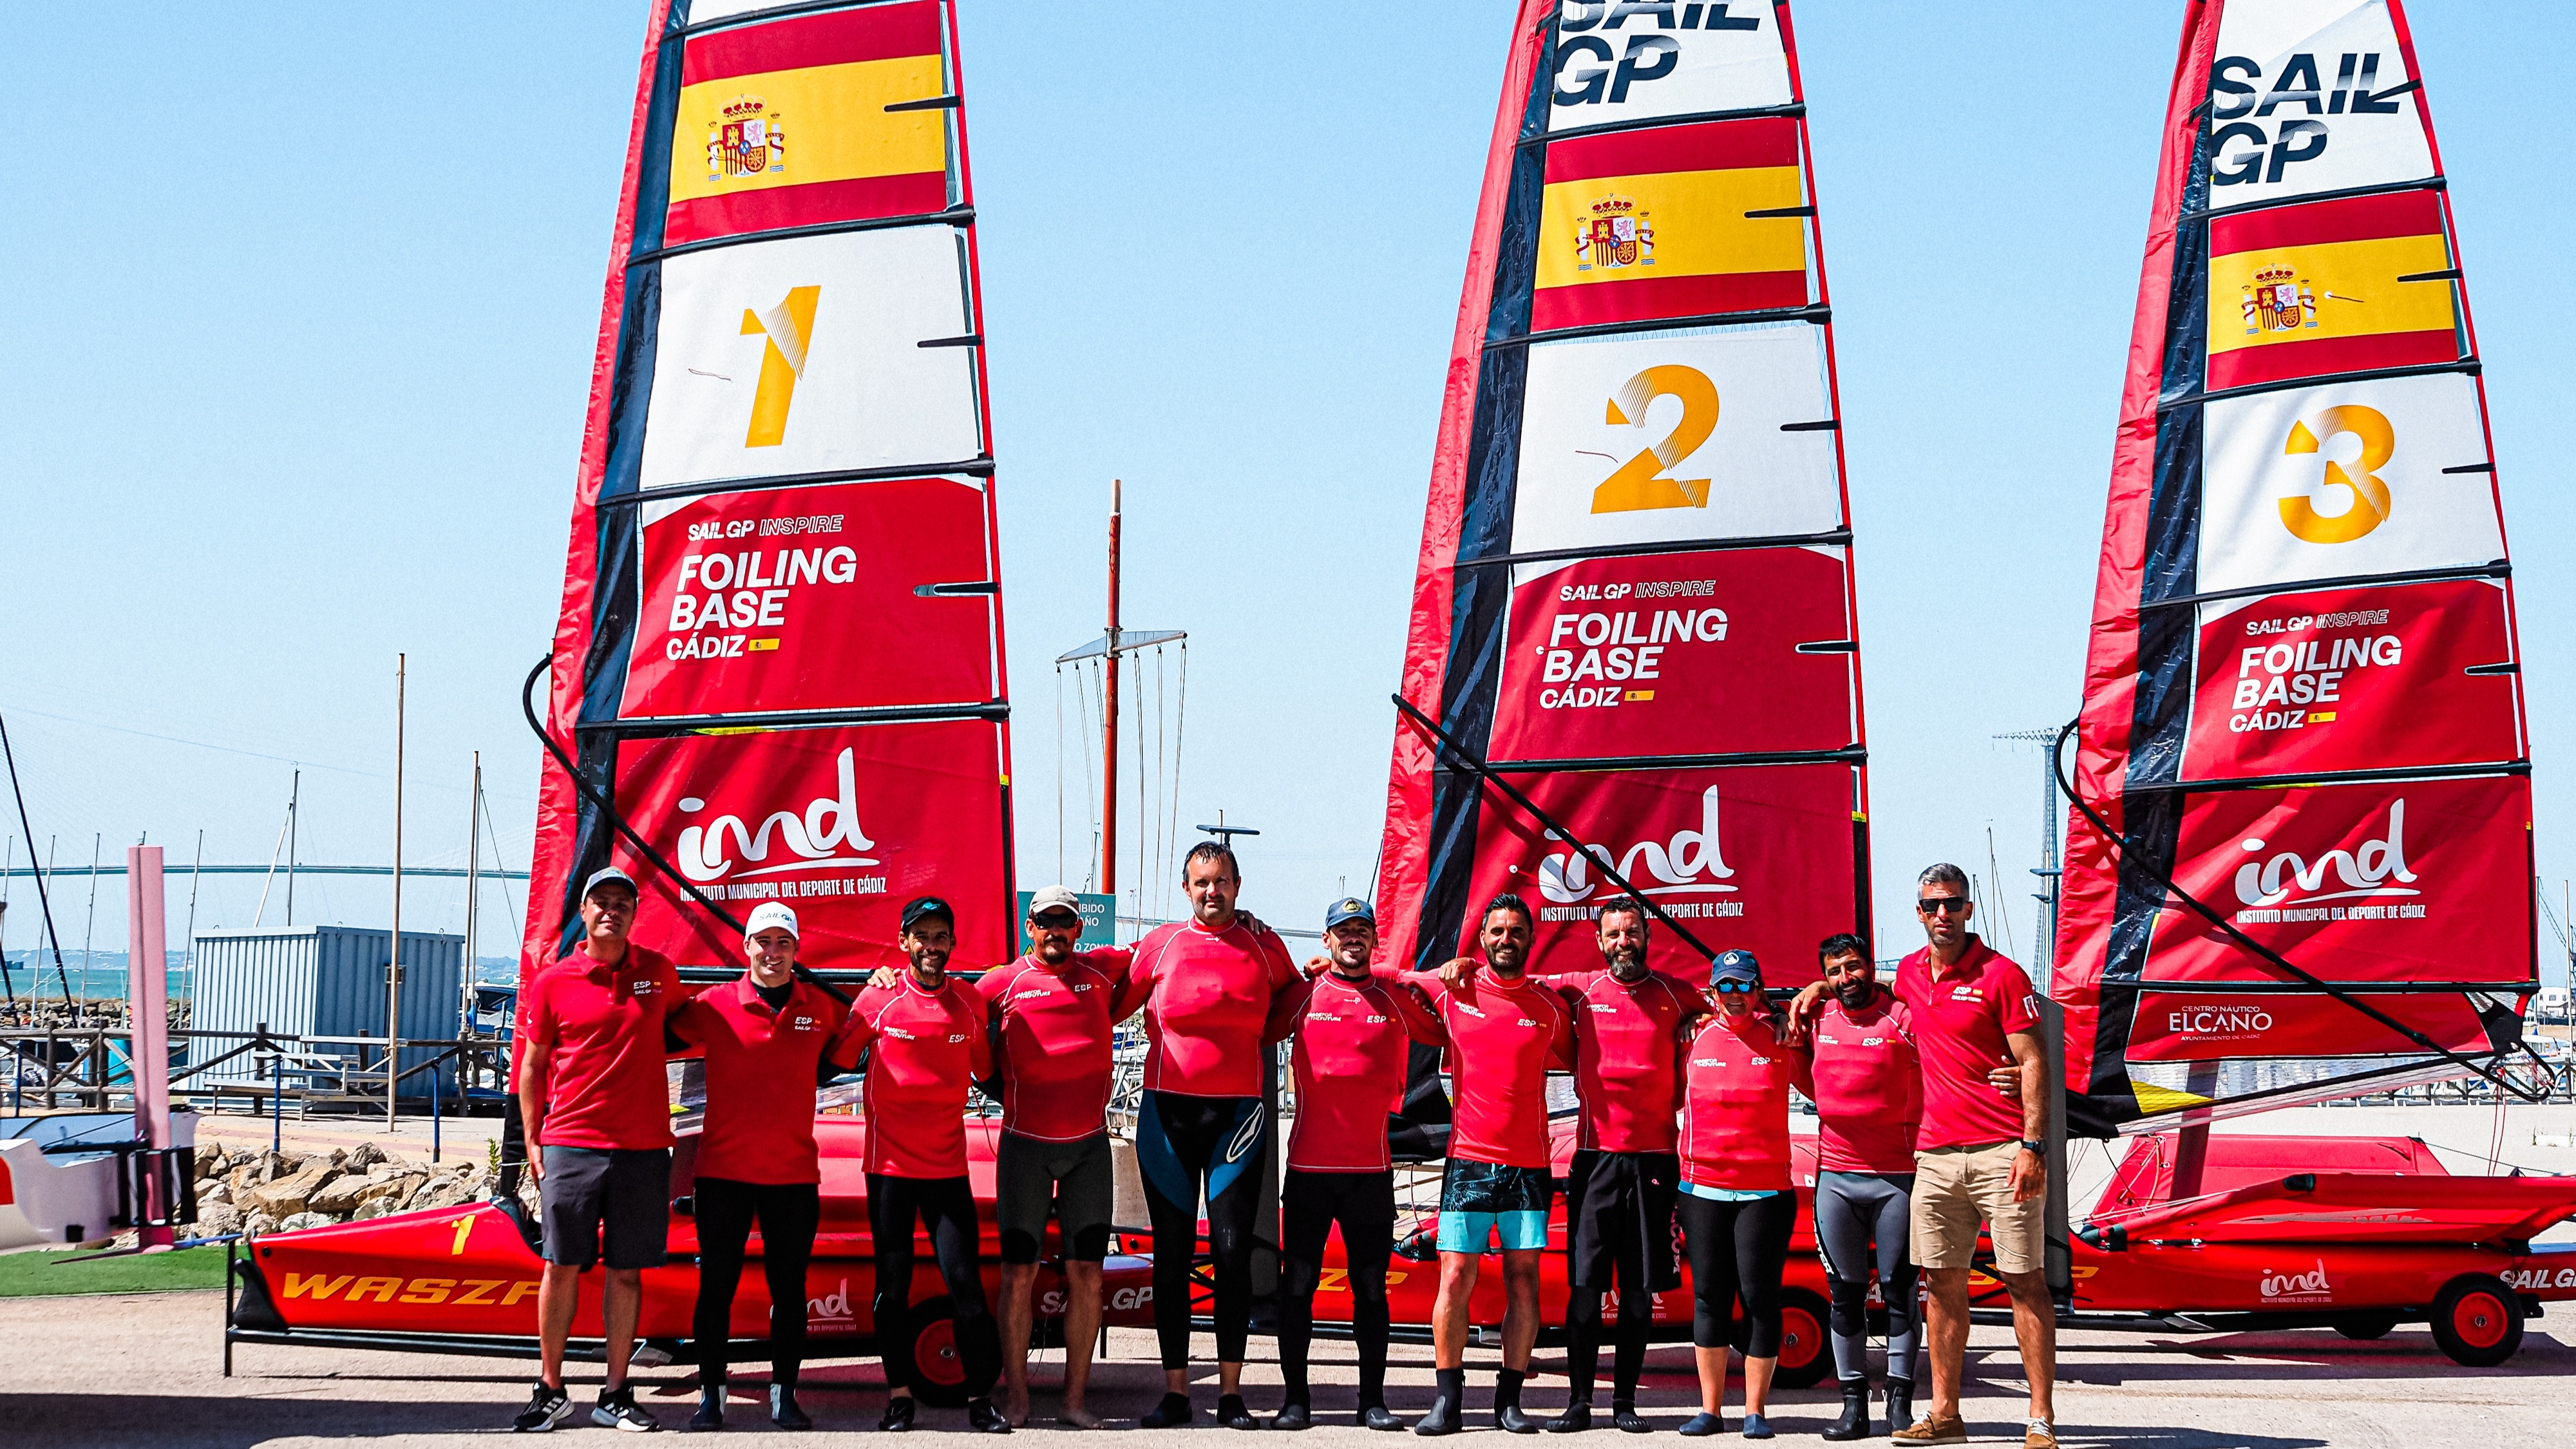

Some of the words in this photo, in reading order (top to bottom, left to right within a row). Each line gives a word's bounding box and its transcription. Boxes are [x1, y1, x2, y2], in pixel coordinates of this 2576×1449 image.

[1553, 35, 1681, 106] GP
[2213, 53, 2400, 119] SAIL
[2211, 120, 2330, 186] GP
[740, 285, 821, 448] 1
[1591, 365, 1719, 514] 2
[2278, 405, 2394, 544] 3
[759, 515, 844, 536] INSPIRE
[677, 545, 857, 592] FOILING
[1635, 580, 1716, 598] INSPIRE
[668, 589, 790, 632] BASE
[2316, 609, 2389, 629] INSPIRE
[1549, 608, 1728, 647] FOILING
[666, 632, 746, 661] CÁDIZ
[2239, 635, 2402, 679] FOILING
[1542, 646, 1665, 683] BASE
[1539, 683, 1622, 709] CÁDIZ
[2232, 672, 2343, 709] BASE
[2229, 708, 2306, 733] CÁDIZ
[677, 746, 875, 881] imd
[2235, 798, 2418, 907] imd
[728, 882, 780, 900] MUNICIPAL
[782, 881, 799, 897] DEL
[800, 879, 841, 896] DEPORTE
[843, 879, 855, 895] DE
[857, 875, 887, 893] CÁDIZ
[1083, 916, 1099, 926] ÑO
[1541, 906, 1587, 921] INSTITUTO
[1661, 903, 1700, 918] DEPORTE
[1703, 903, 1714, 918] DE
[1716, 900, 1743, 917] CÁDIZ
[2237, 909, 2280, 923] INSTITUTO
[2282, 908, 2329, 923] MUNICIPAL
[2331, 907, 2346, 921] DEL
[2348, 906, 2385, 921] DEPORTE
[2387, 905, 2398, 918] DE
[2400, 902, 2426, 918] CÁDIZ
[634, 981, 650, 989] ESP
[1075, 984, 1092, 992] ESP
[2220, 1004, 2260, 1012] NÁUTICO
[1517, 1018, 1537, 1027] ESP
[2169, 1012, 2272, 1032] ELCANO
[949, 1034, 965, 1043] ESP
[1862, 1037, 1883, 1046] ESP
[1751, 1057, 1770, 1065] ESP
[451, 1215, 476, 1255] 1
[2555, 1269, 2576, 1287] G
